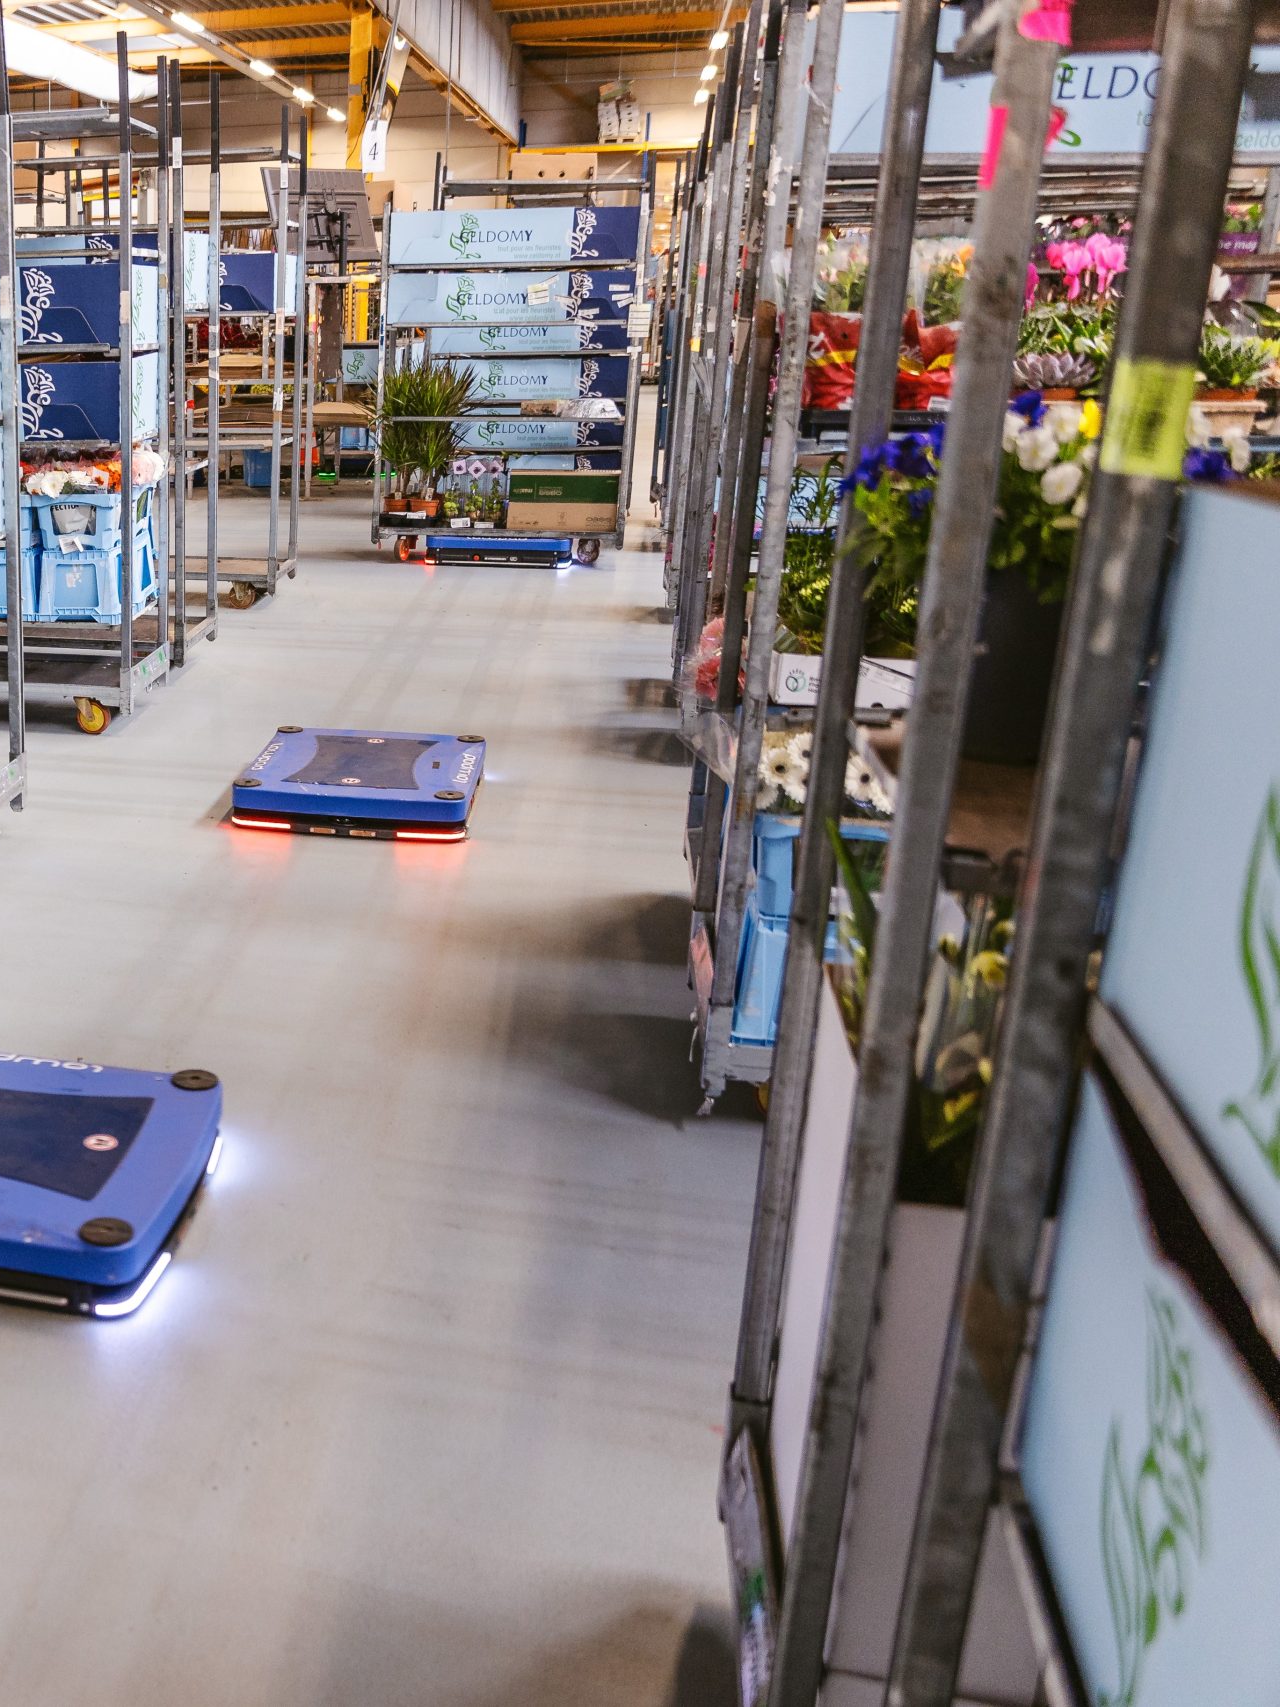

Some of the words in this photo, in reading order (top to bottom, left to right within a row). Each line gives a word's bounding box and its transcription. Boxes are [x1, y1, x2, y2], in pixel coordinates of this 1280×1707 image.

[368, 142, 379, 161] 4
[460, 230, 533, 243] CELDOMY
[488, 375, 548, 386] CELDOMY
